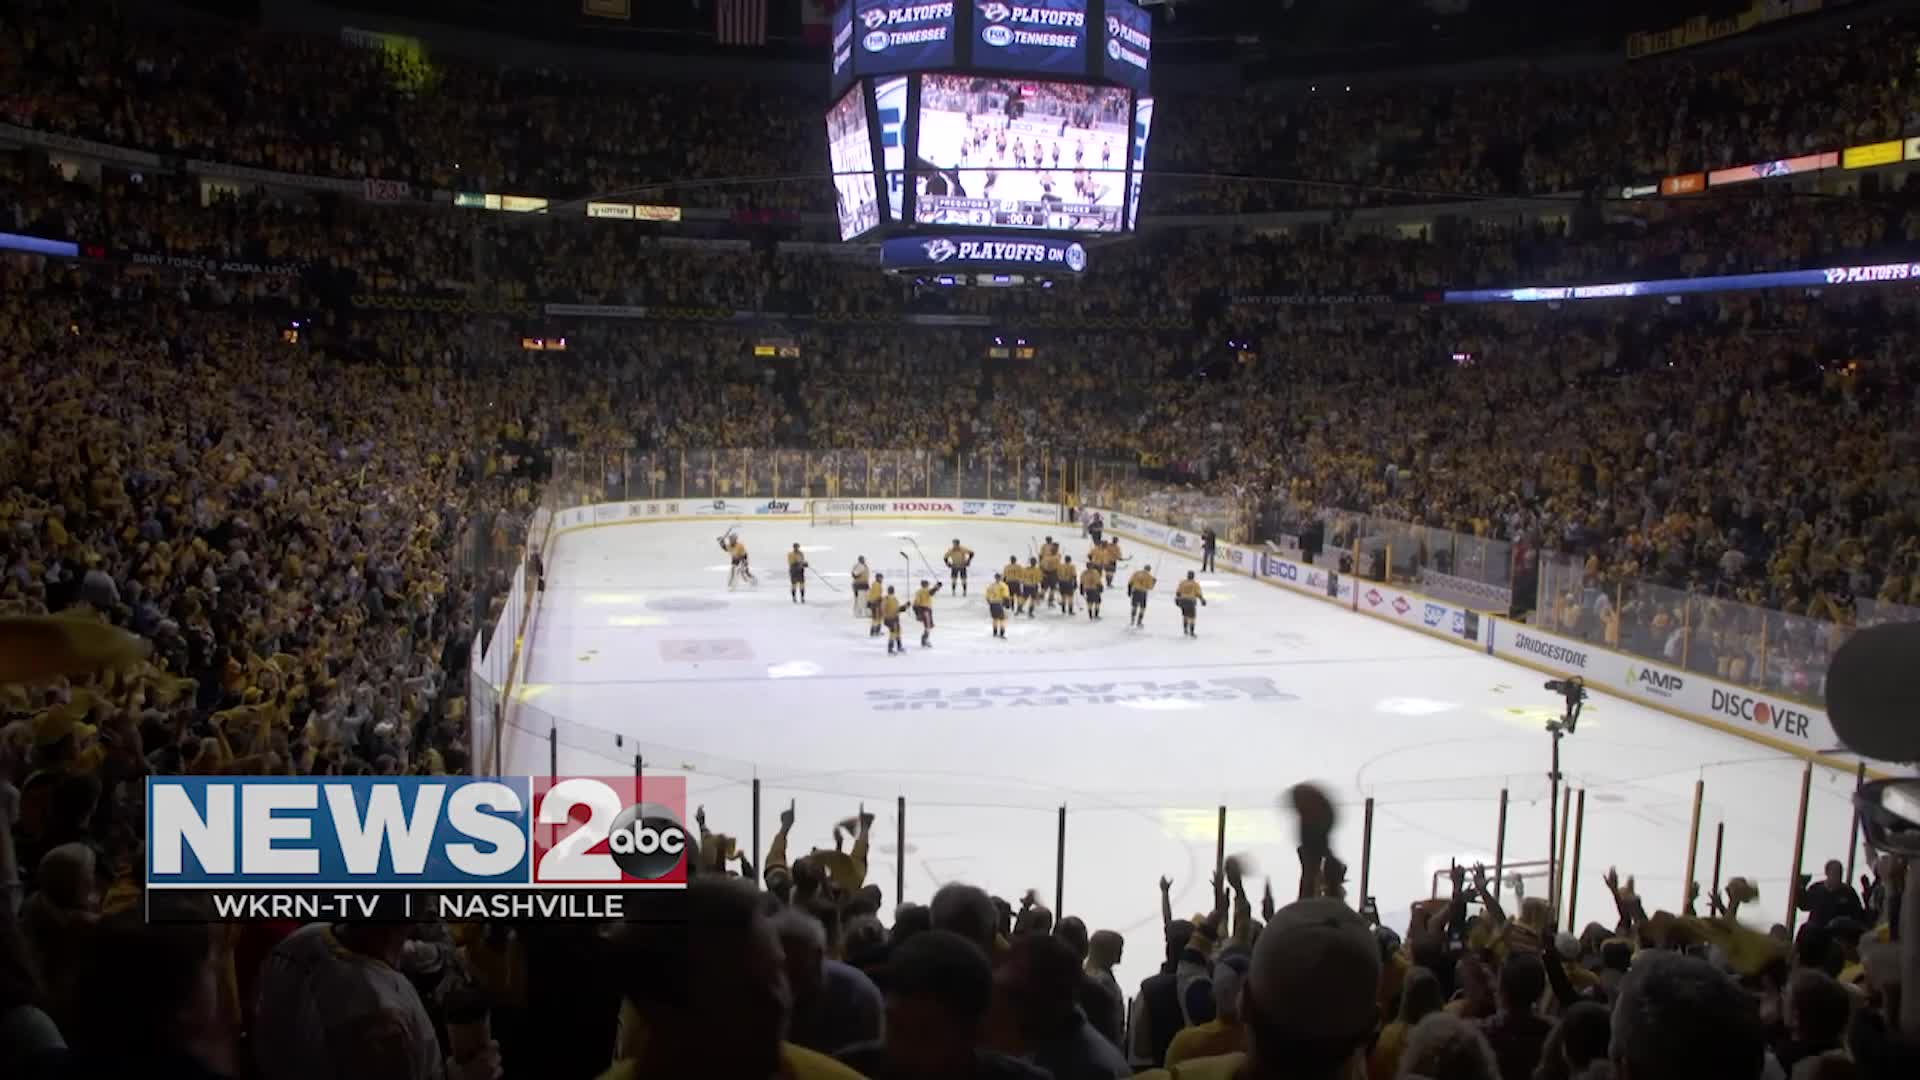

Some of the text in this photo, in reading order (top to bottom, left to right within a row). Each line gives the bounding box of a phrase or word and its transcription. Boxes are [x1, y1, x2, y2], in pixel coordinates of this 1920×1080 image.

[887, 3, 953, 24] PLAYOFFS
[1010, 7, 1084, 27] PLAYOFFS
[890, 27, 946, 46] TENNESSEE
[1014, 30, 1077, 48] TENNESSEE
[940, 199, 988, 208] PREDATORS
[976, 212, 983, 223] 3
[957, 242, 1045, 262] PLAYOFFS
[1048, 248, 1064, 261] ON
[1847, 263, 1909, 281] PLAYOFFS
[768, 500, 789, 512] day
[892, 502, 954, 512] HONDA
[1269, 559, 1297, 581] EICO
[1424, 603, 1448, 626] SAP
[1515, 632, 1588, 669] BRIDGESTONE
[1639, 668, 1684, 691] AMP
[1711, 688, 1810, 739] DISCOVER
